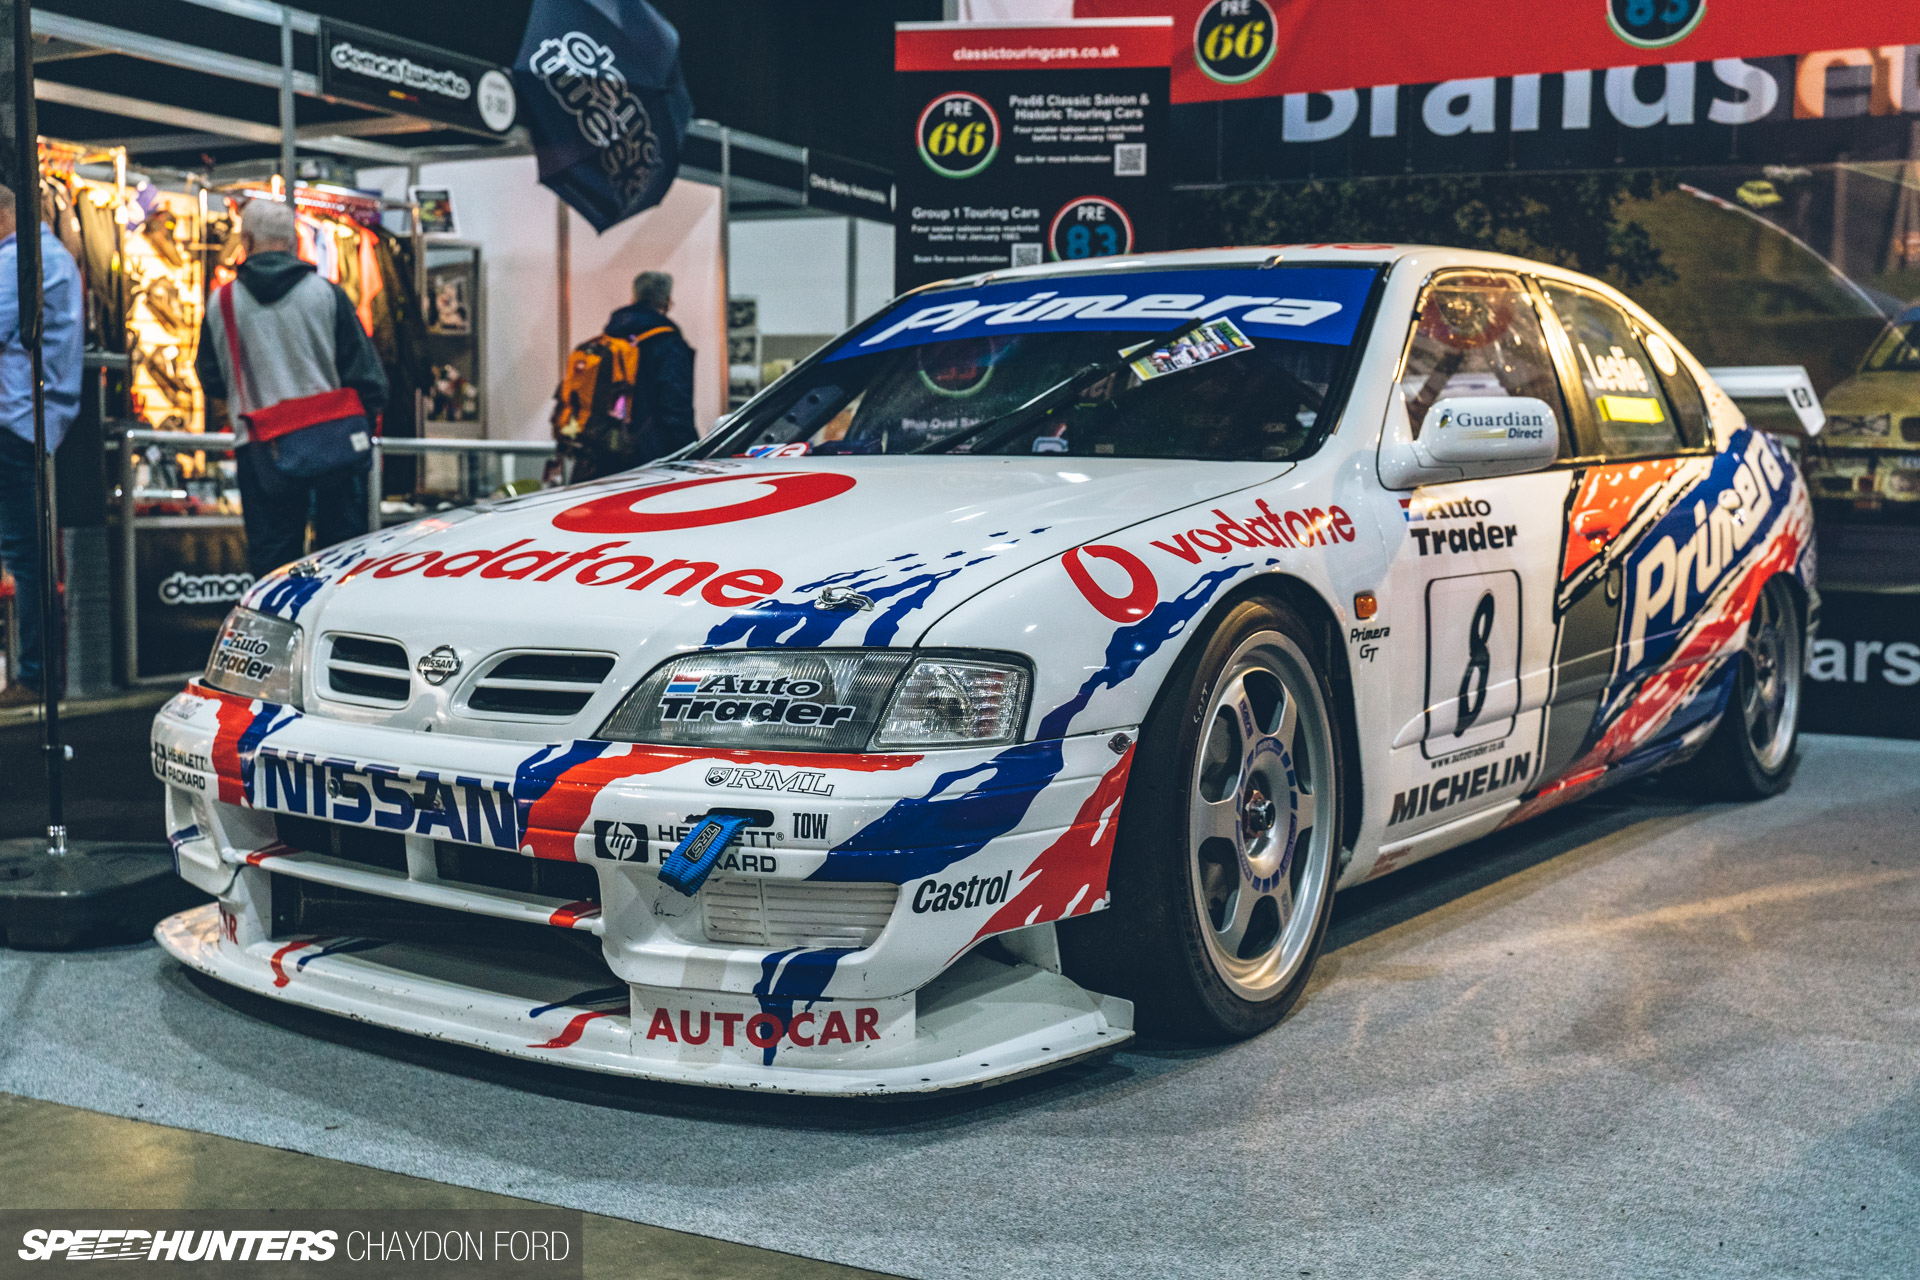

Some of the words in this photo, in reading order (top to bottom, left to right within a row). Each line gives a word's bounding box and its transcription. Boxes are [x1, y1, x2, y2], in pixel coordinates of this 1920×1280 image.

[953, 45, 1120, 62] classictouringcars.co.uk
[1204, 20, 1265, 62] 66
[944, 101, 973, 117] PRE
[1015, 108, 1063, 120] Historic
[1065, 107, 1112, 121] Touring
[1114, 107, 1144, 119] Cars
[1047, 94, 1092, 107] Classic
[1094, 93, 1138, 106] Saloon
[1139, 93, 1150, 105] &
[928, 121, 987, 156] 66
[912, 206, 951, 221] Group
[952, 207, 960, 219] 1
[962, 206, 1009, 221] Touring
[1011, 206, 1040, 218] Cars
[1077, 206, 1105, 221] PRE
[1066, 224, 1118, 259] 83
[1456, 412, 1543, 427] Guardian
[1508, 428, 1543, 439] Direct
[1425, 497, 1492, 520] Auto
[1149, 498, 1357, 564] vodafone
[1410, 521, 1518, 556] Trader
[337, 538, 785, 607] vodafone
[159, 571, 256, 605] demon
[228, 631, 270, 656] Auto
[1349, 625, 1391, 644] Primera
[215, 650, 274, 682] Trader
[420, 658, 454, 669] NISSAN
[1360, 644, 1380, 663] GT
[1454, 588, 1496, 738] 8
[1806, 639, 1920, 686] ars
[697, 673, 823, 698] Auto
[659, 695, 856, 728] Trader
[1431, 740, 1505, 769] www.autotrader.co.uk
[167, 766, 206, 790] PACKARD
[727, 768, 835, 796] RML
[1387, 752, 1531, 827] MICHELIN
[260, 746, 518, 850] NISSAN
[793, 812, 828, 839] TOW
[610, 821, 634, 861] hp
[658, 849, 777, 873] PARD
[911, 870, 1013, 915] Castrol
[646, 1006, 881, 1049] AUTOCAR
